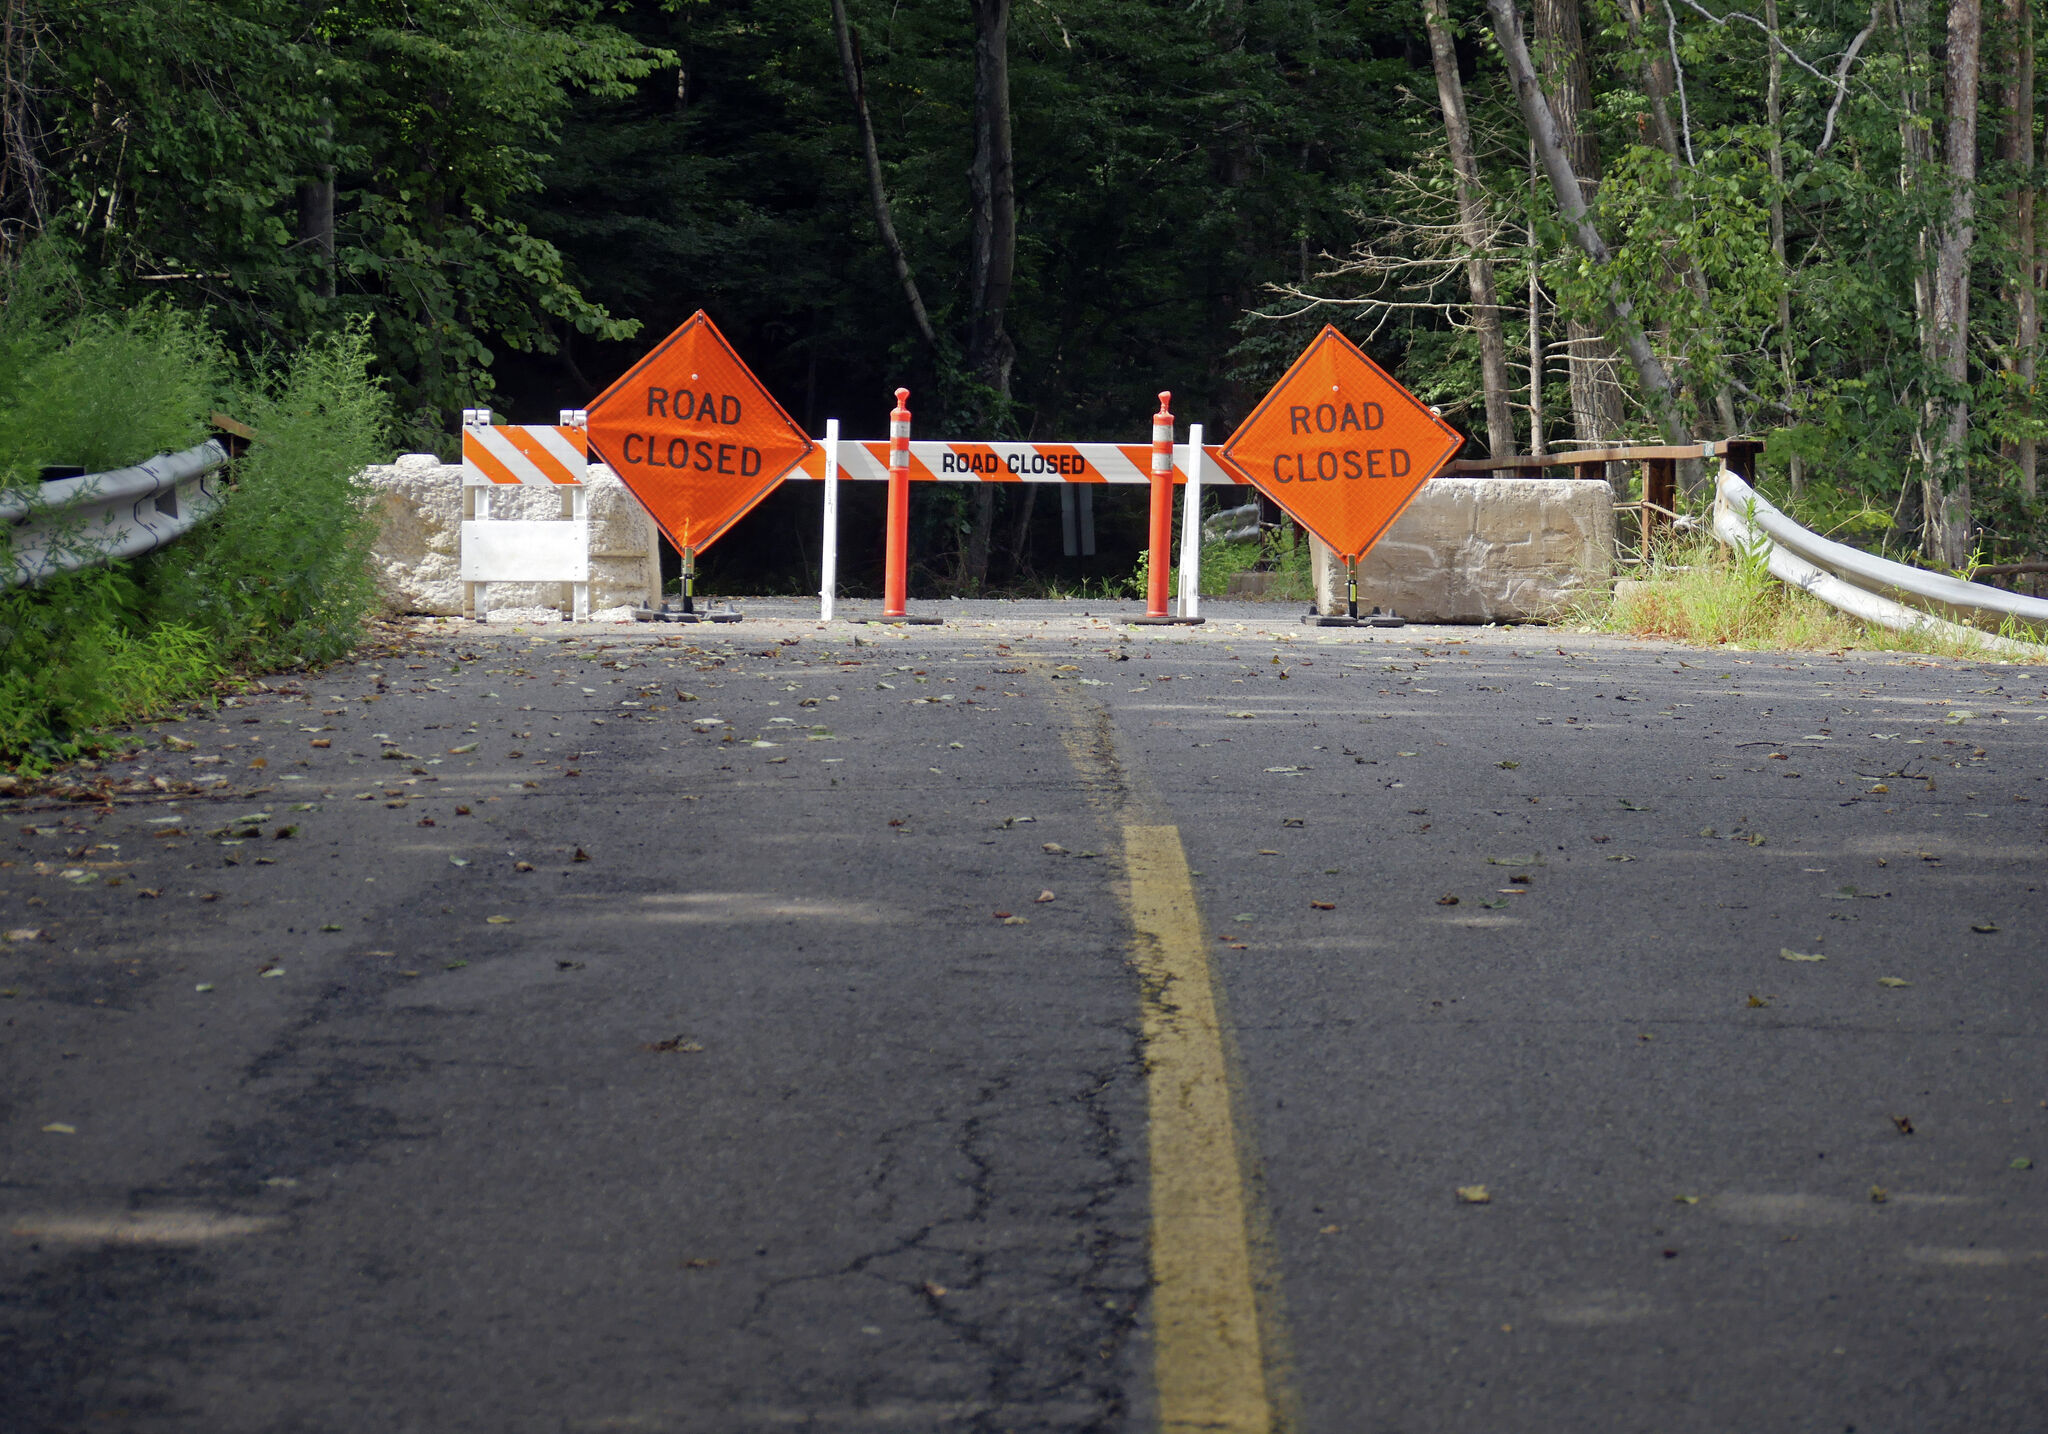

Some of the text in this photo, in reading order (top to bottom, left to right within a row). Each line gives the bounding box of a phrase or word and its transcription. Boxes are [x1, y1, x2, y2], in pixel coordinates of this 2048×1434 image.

[647, 386, 742, 425] ROAD
[1290, 401, 1384, 435] ROAD
[623, 433, 761, 477] CLOSED
[942, 452, 1085, 475] ROAD CLOSED
[1273, 448, 1411, 484] CLOSED
